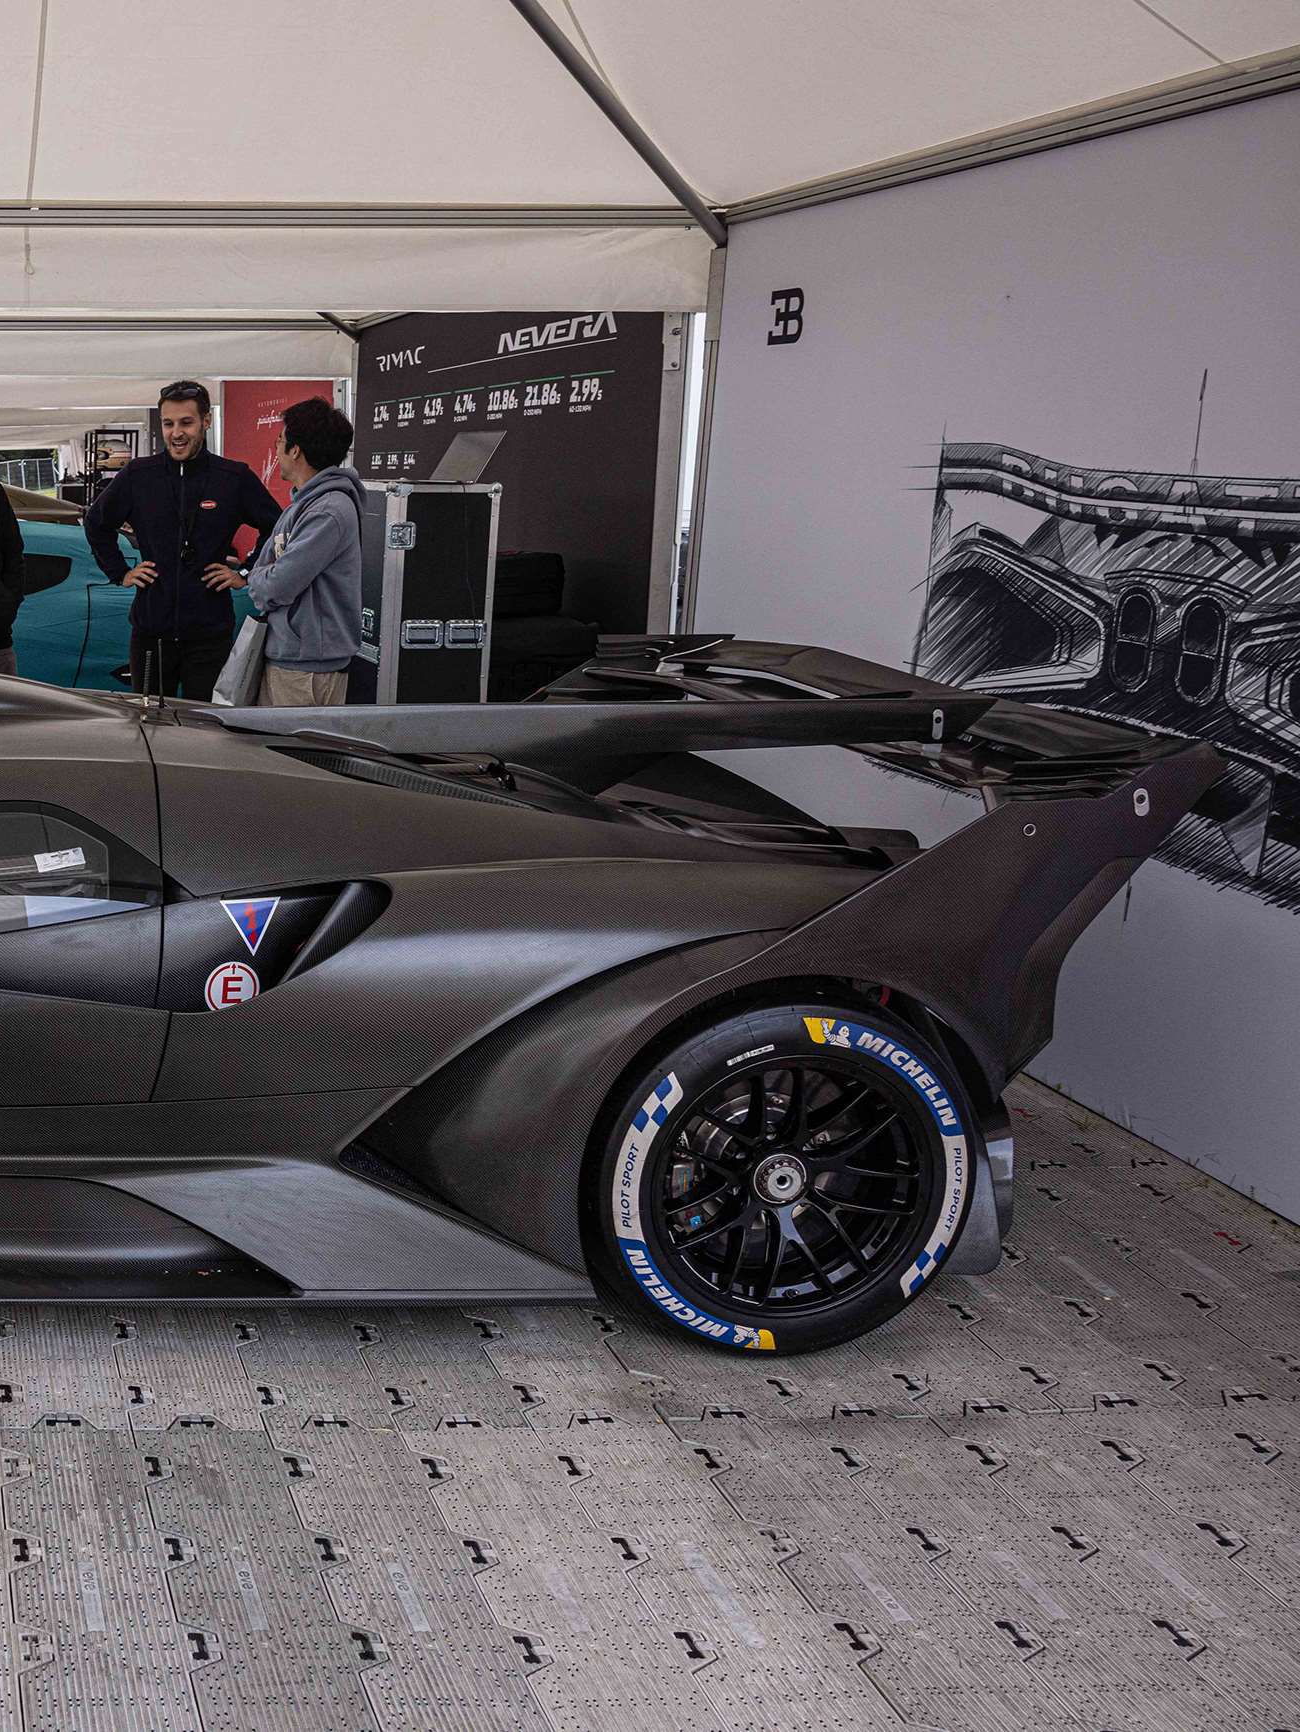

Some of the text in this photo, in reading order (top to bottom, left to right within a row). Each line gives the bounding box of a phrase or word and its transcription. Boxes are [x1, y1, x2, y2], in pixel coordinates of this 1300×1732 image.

[376, 345, 426, 373] RIMAC
[423, 398, 444, 417] 4.19s
[454, 394, 477, 414] 4.74s
[487, 389, 519, 412] 10.86s
[524, 383, 561, 407] 21.86s
[569, 378, 603, 403] 2.99s
[221, 976, 243, 1004] E
[856, 1031, 957, 1127] MICHELIN
[620, 1143, 640, 1229] PILOT SPORT
[945, 1147, 963, 1232] PILOT SPORT
[626, 1248, 730, 1338] MICHELIN
